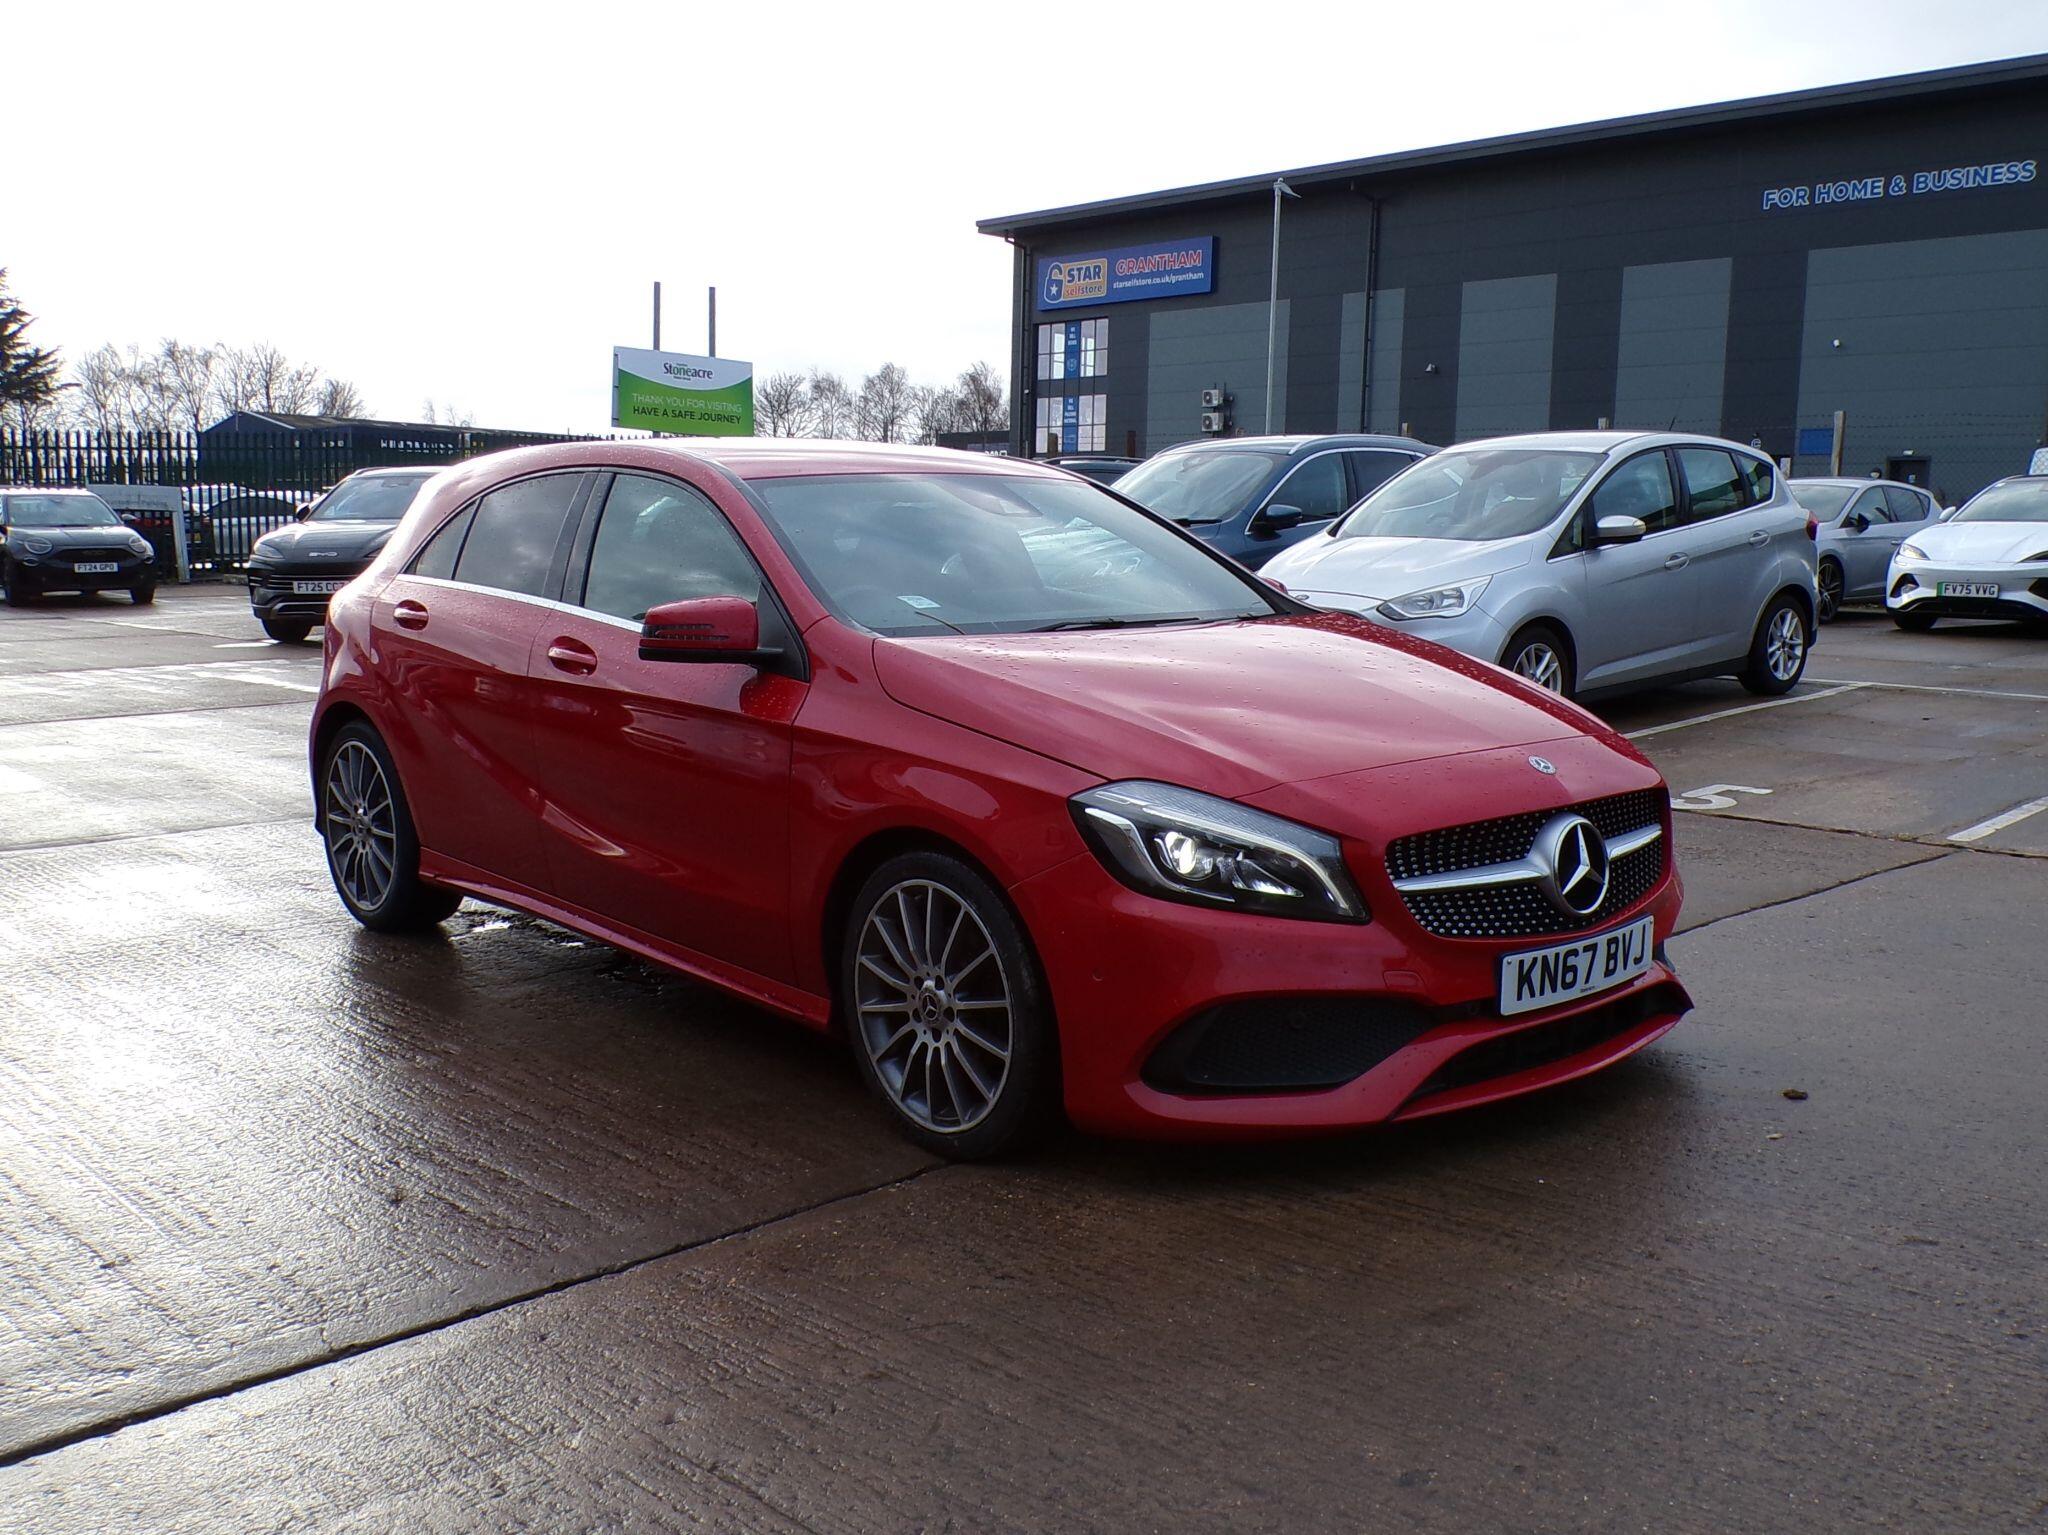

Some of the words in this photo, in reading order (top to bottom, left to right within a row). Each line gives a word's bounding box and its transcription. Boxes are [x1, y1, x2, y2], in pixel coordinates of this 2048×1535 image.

[1762, 186, 1810, 210] FOR
[1814, 177, 1885, 204] HOME
[1888, 175, 1907, 196] &
[1912, 159, 2037, 194] BUSINESS
[1115, 249, 1203, 277] GRANTHAM
[1066, 264, 1102, 285] STAR
[1112, 271, 1204, 289] starselfstore.co.uk/grantham
[1065, 284, 1102, 297] selfstore
[663, 362, 713, 380] Stoneacre
[632, 393, 664, 405] THANK
[666, 396, 685, 407] YOU
[686, 398, 705, 409] FOR
[706, 401, 742, 413] VISITING
[632, 405, 659, 417] HAVE
[661, 408, 671, 418] A
[671, 409, 695, 420] SAFE
[698, 412, 742, 425] JOURNEY
[297, 582, 323, 592] FT25
[1944, 584, 1972, 595] FV75
[1975, 584, 1996, 596] VVG
[1516, 942, 1598, 1002] KN67
[1603, 923, 1647, 979] BVJ
